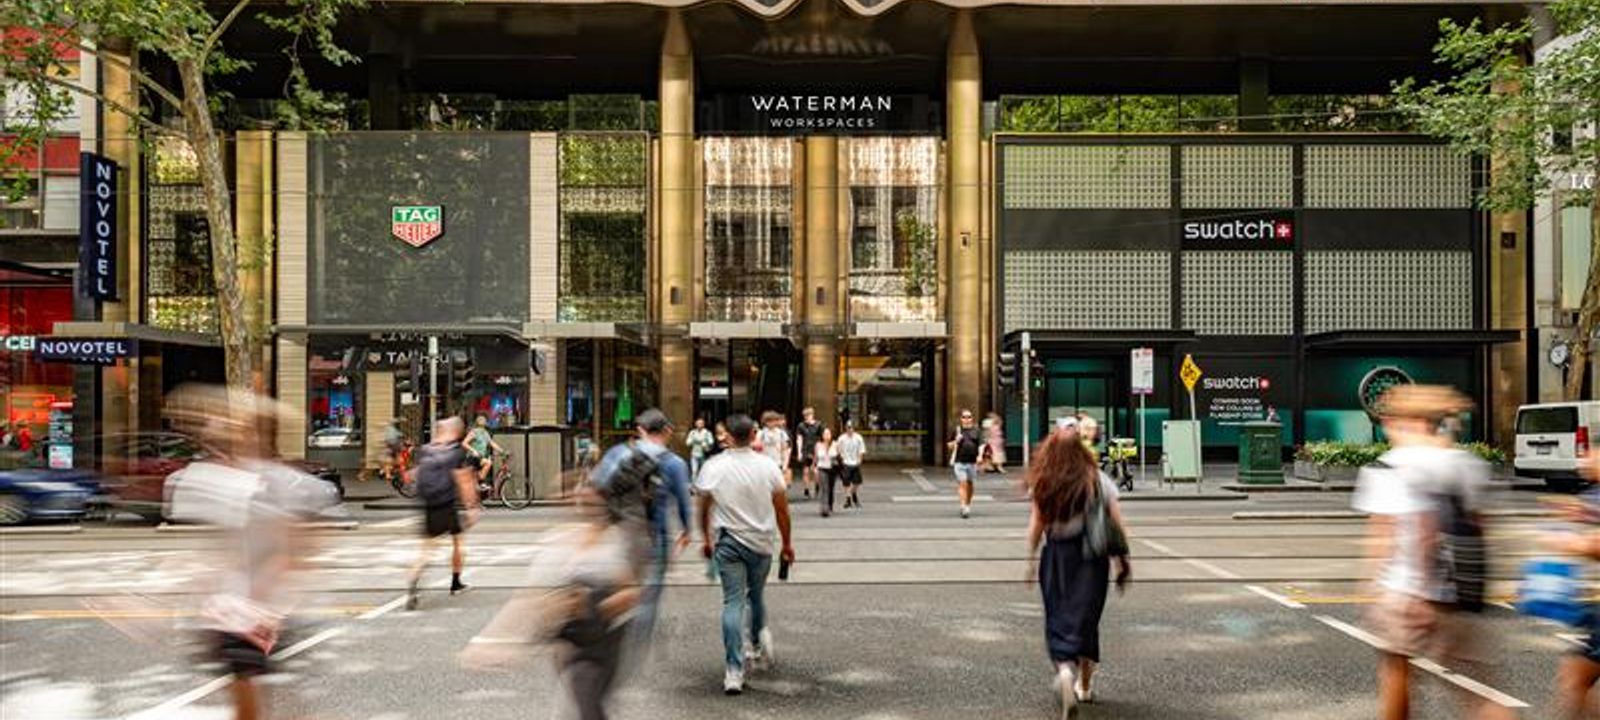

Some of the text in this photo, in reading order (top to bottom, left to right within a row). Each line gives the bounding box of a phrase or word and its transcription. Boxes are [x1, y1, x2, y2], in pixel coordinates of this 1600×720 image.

[751, 96, 892, 111] WATERMAN
[770, 118, 875, 127] WORKSPACES
[397, 209, 438, 221] TAG
[96, 162, 111, 294] NOVOTEL
[395, 223, 439, 241] HEUER
[1184, 220, 1274, 239] swatch
[41, 342, 127, 354] NOVOTEL
[1203, 377, 1260, 389] swatch
